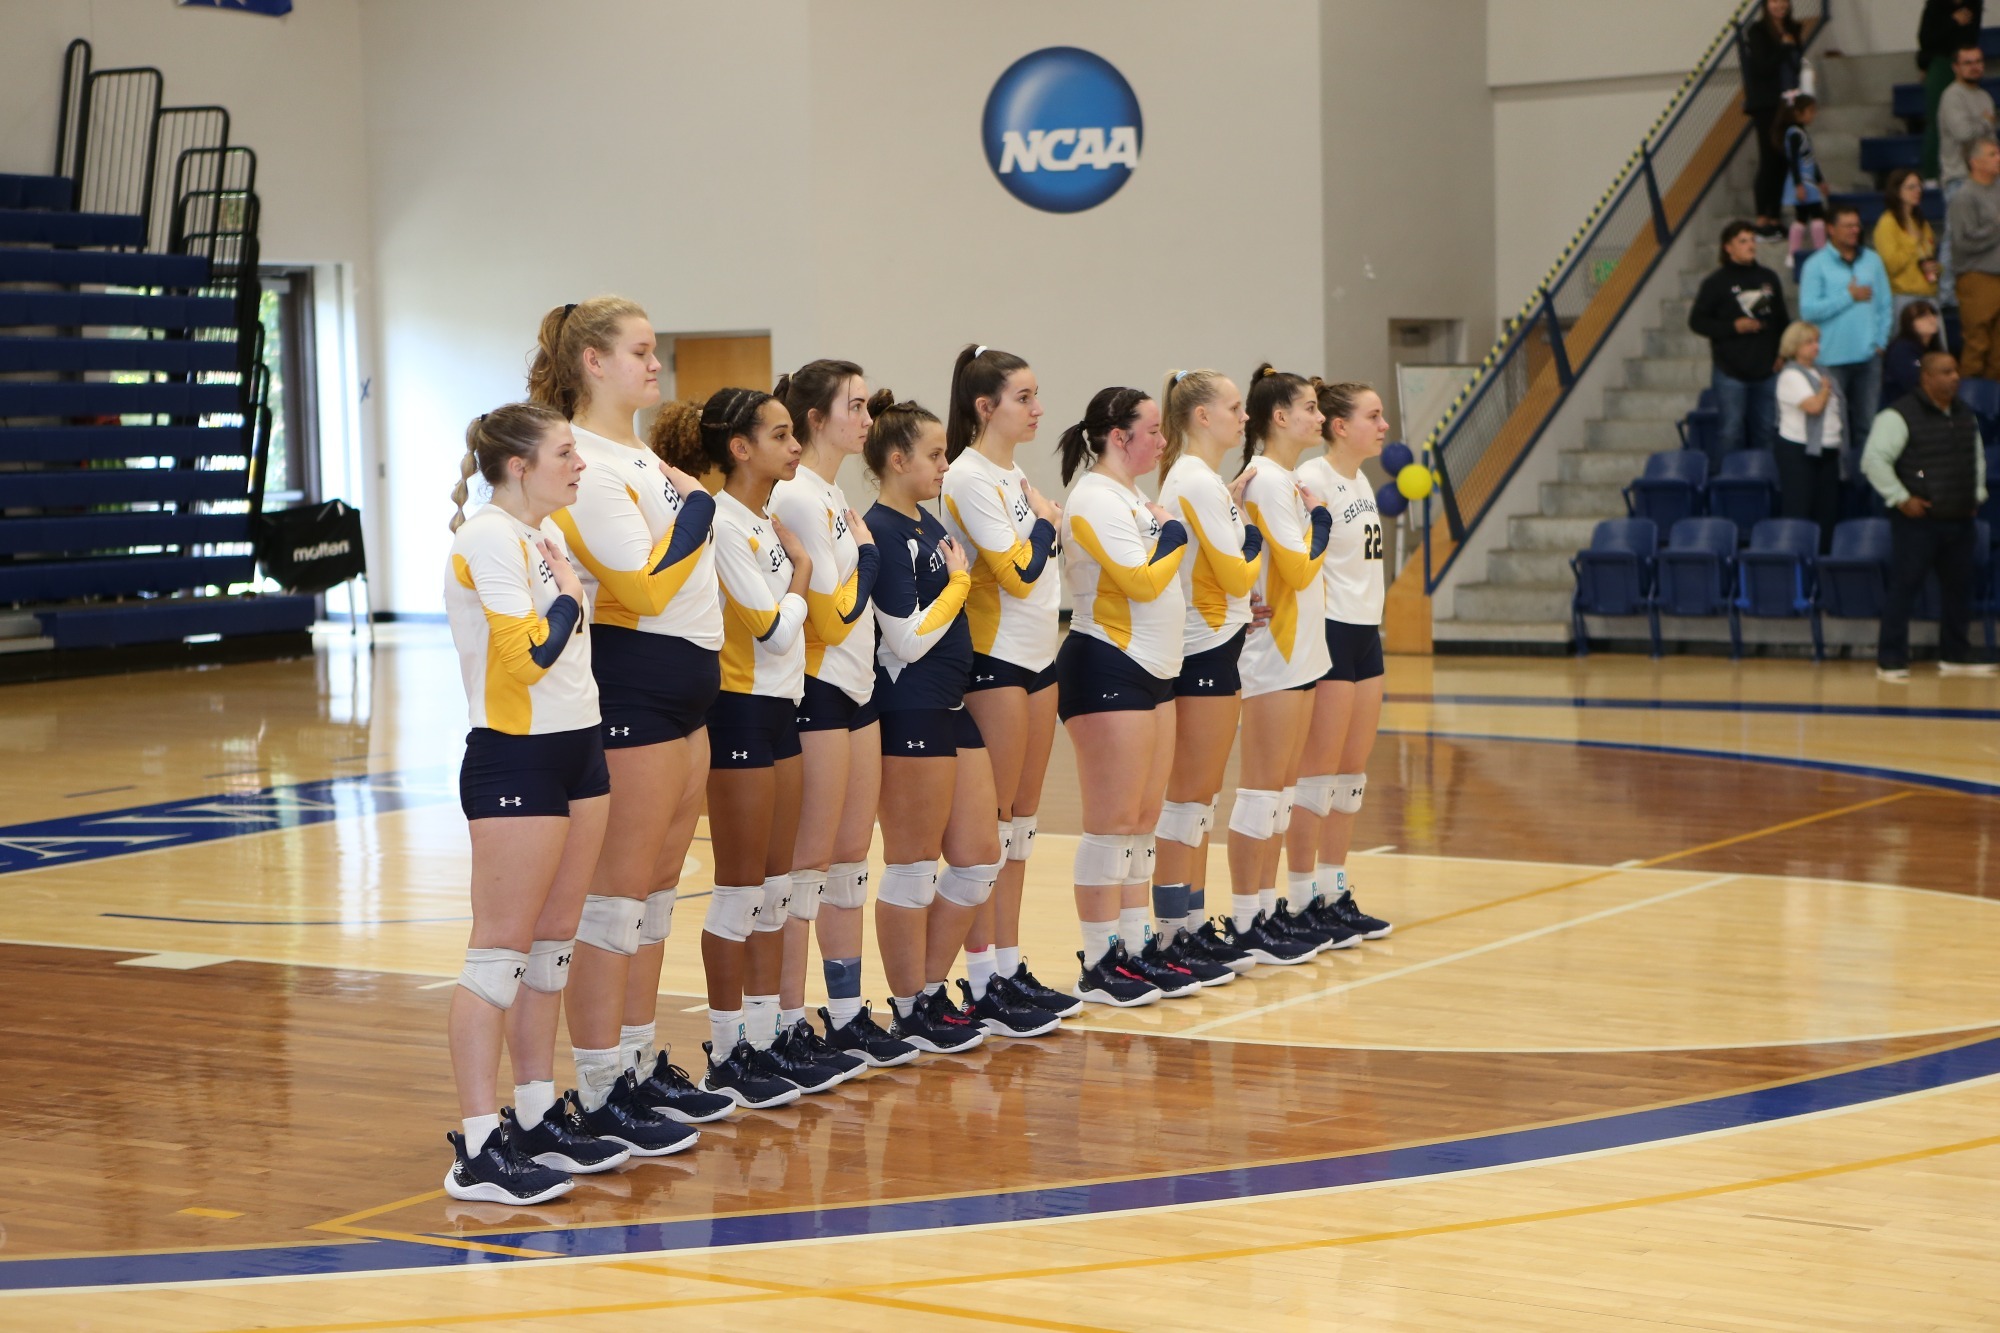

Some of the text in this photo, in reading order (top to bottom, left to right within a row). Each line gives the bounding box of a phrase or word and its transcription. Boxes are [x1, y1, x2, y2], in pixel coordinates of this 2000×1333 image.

[999, 126, 1138, 173] NCAA
[293, 540, 350, 562] molten
[1364, 524, 1383, 560] 22
